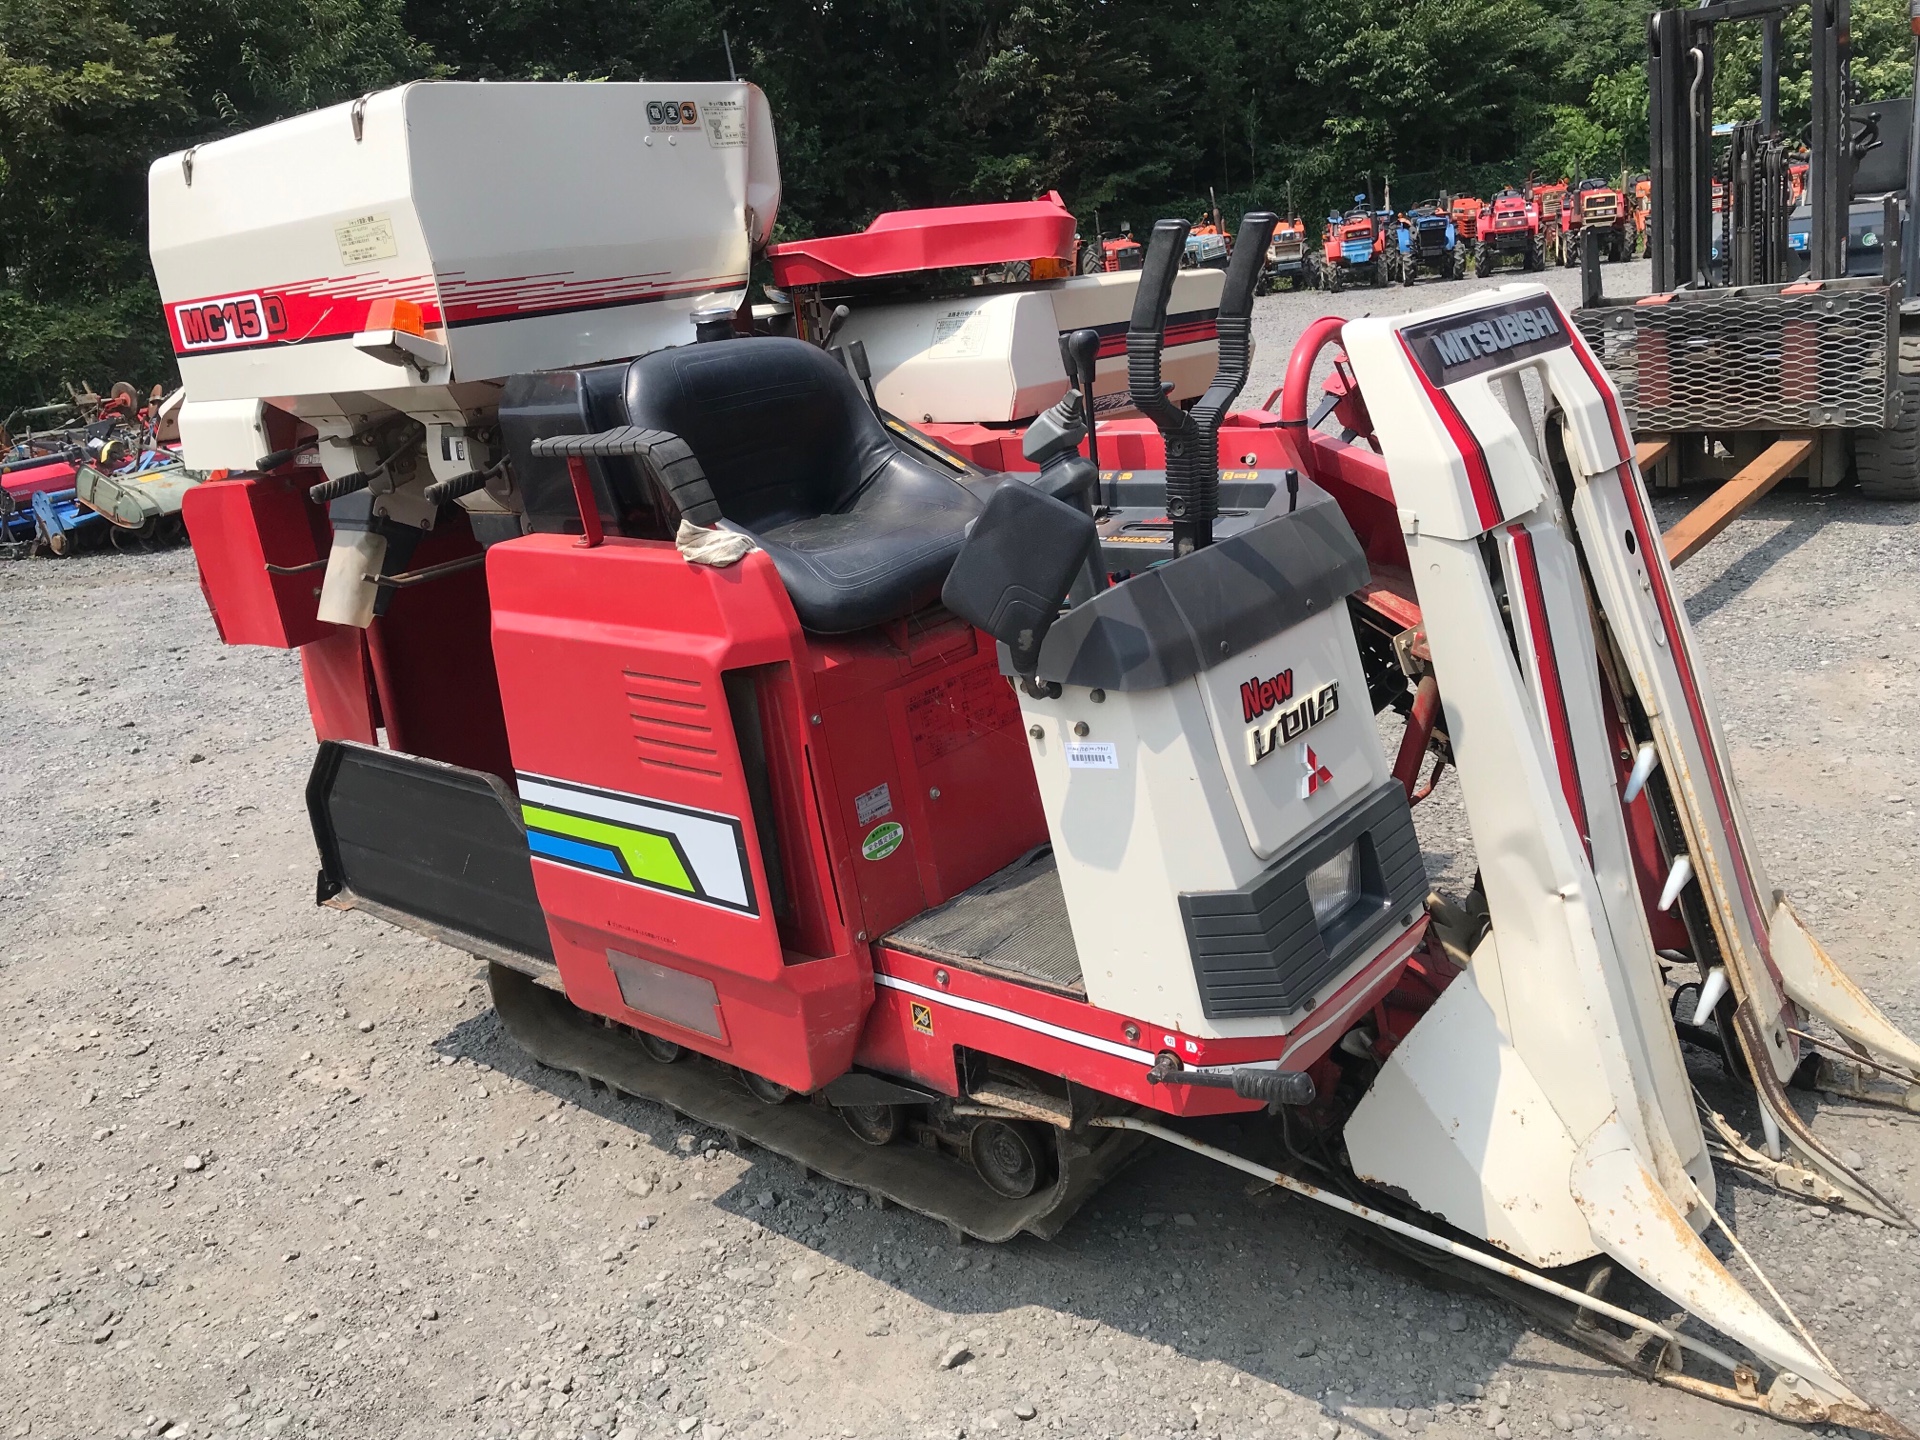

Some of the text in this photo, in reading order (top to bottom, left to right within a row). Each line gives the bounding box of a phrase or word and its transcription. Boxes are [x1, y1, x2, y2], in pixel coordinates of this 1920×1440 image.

[1839, 58, 1847, 157] TOYOTA
[1430, 306, 1560, 367] MITSUBISHI
[1240, 668, 1293, 724] New
